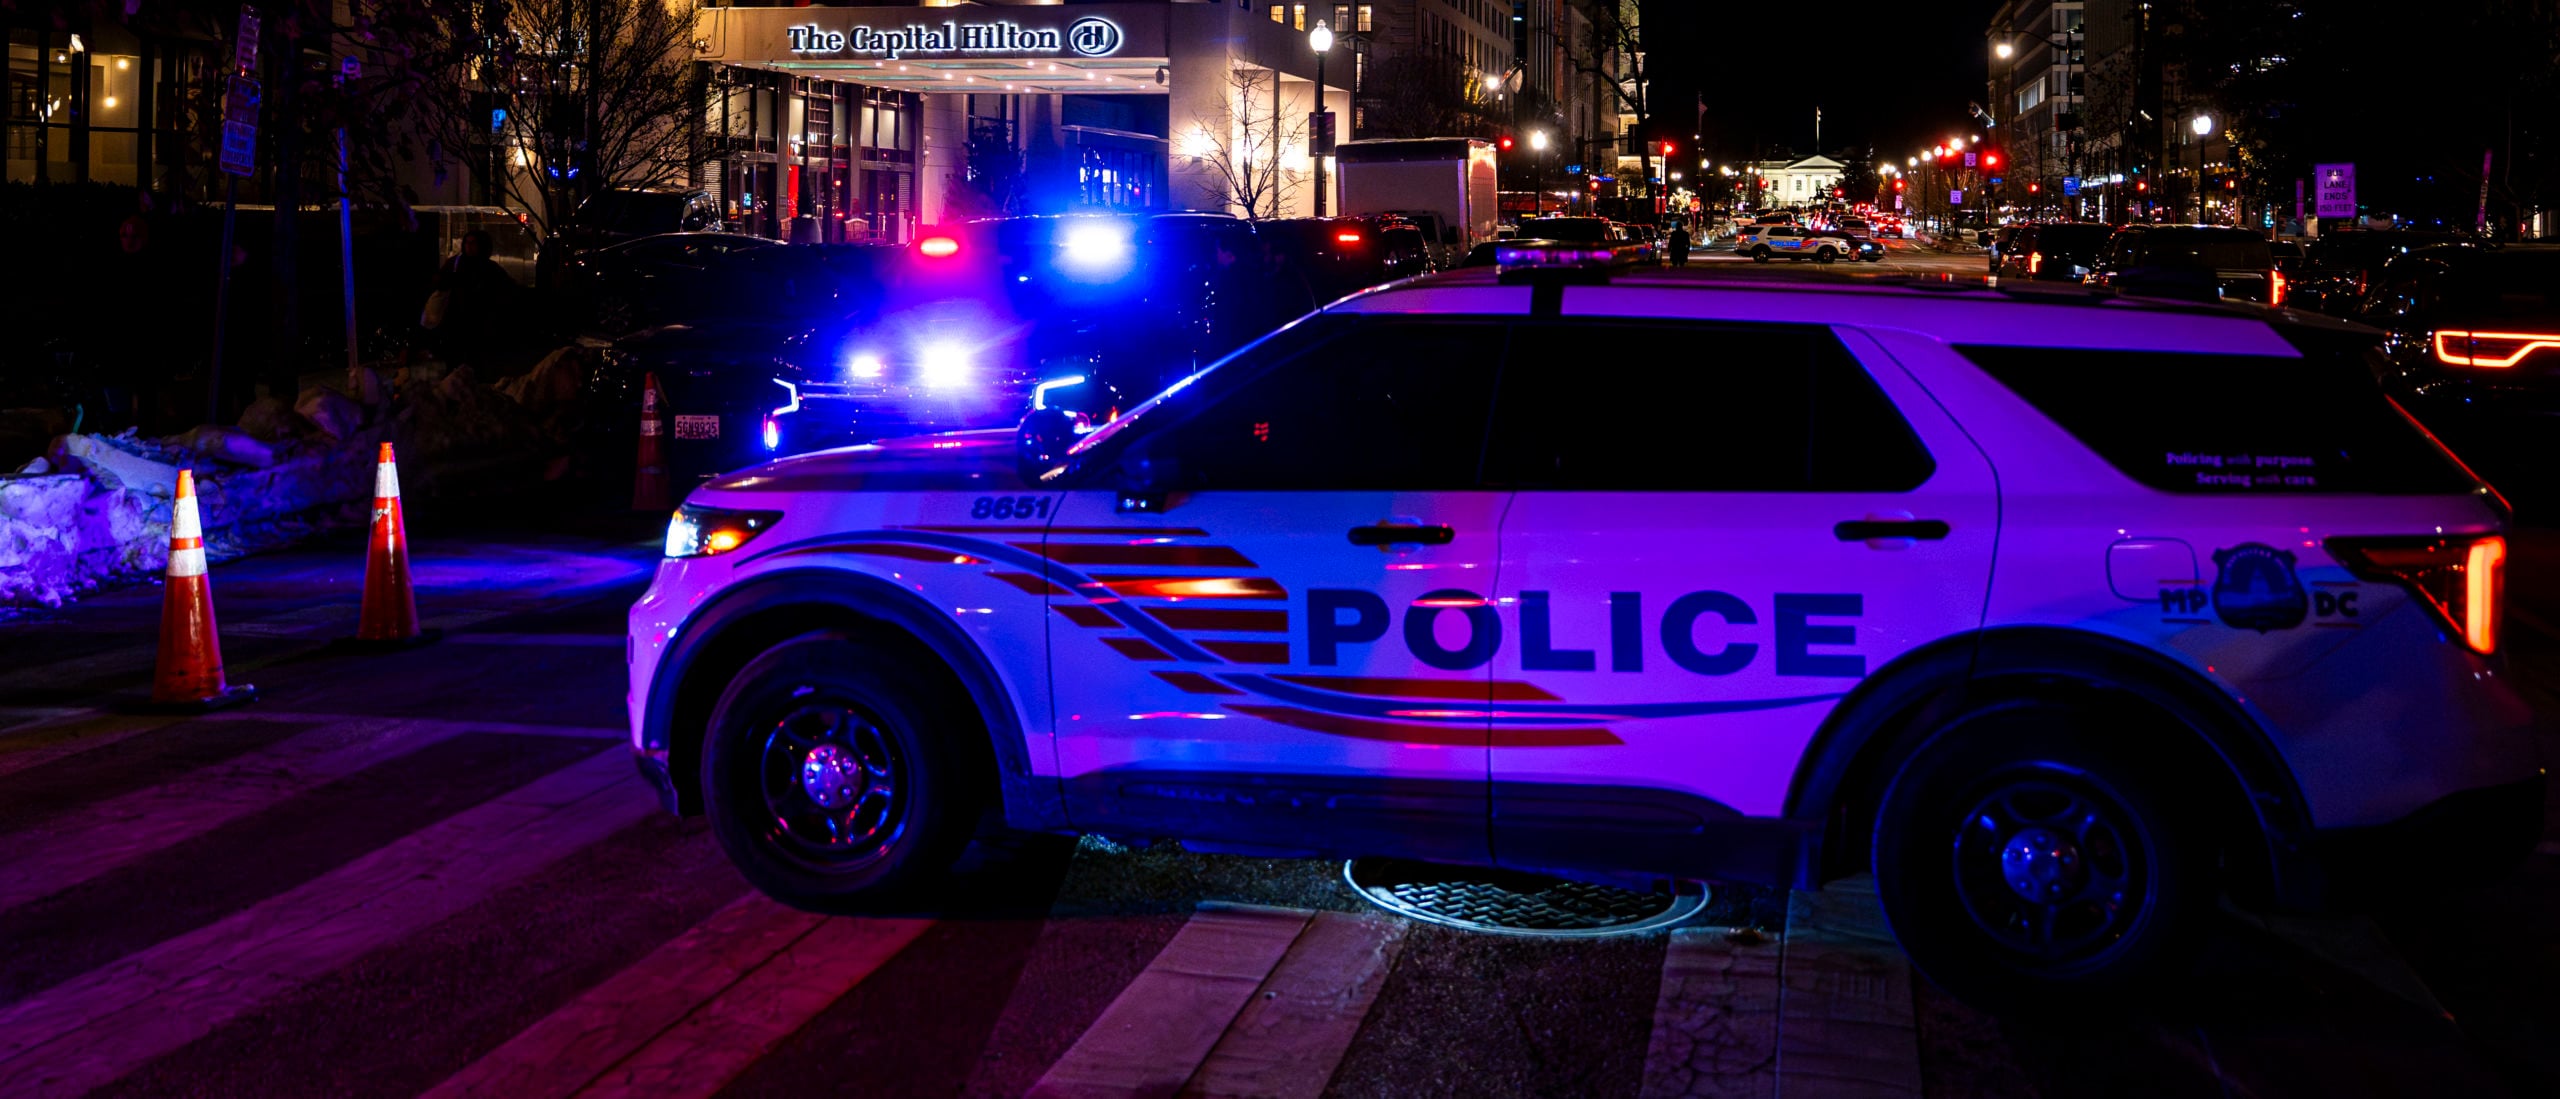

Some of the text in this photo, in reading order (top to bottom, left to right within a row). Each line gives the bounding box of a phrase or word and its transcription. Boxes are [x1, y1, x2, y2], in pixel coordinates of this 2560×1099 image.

[788, 22, 1059, 60] The Capital Hilton
[2326, 169, 2344, 177] BUS
[2324, 181, 2348, 189] LANE
[2324, 192, 2348, 200] ENDS
[2335, 204, 2353, 212] FEET
[1769, 240, 1801, 248] POLICE
[2166, 452, 2223, 467] Policing
[2197, 472, 2252, 487] Serving
[971, 495, 1052, 520] 8651
[2160, 588, 2208, 614] MP
[2314, 591, 2359, 617] DC
[1306, 588, 1867, 678] POLICE
